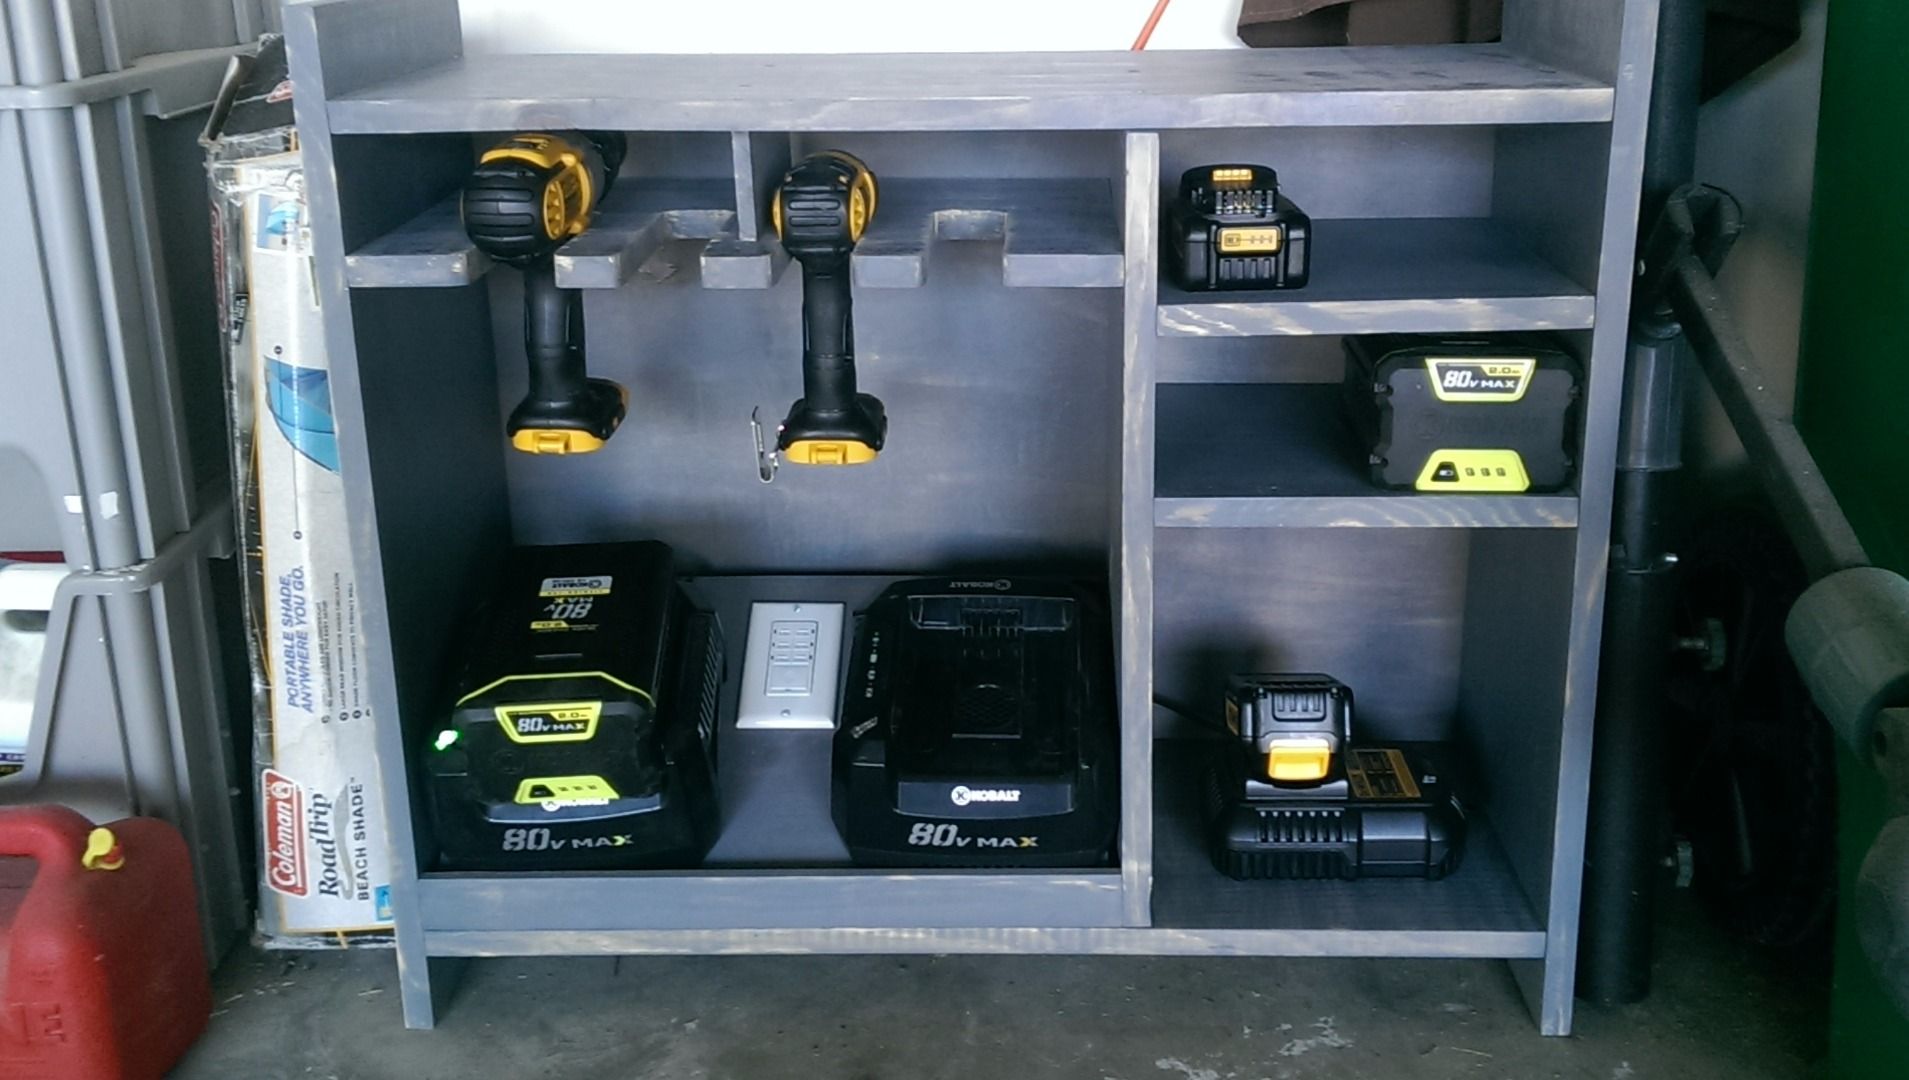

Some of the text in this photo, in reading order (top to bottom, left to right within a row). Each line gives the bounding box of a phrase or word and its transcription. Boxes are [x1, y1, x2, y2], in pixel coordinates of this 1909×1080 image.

[1480, 379, 1516, 389] MAX
[293, 595, 307, 626] YOU
[282, 631, 300, 708] PORTABLE
[295, 631, 314, 713] ANYWHERE
[552, 723, 586, 732] MAX
[970, 789, 1021, 802] KOBALT
[271, 801, 296, 887] Coleman
[571, 834, 634, 849] MAX
[977, 836, 1039, 848] MAX
[354, 847, 370, 901] BEACH
